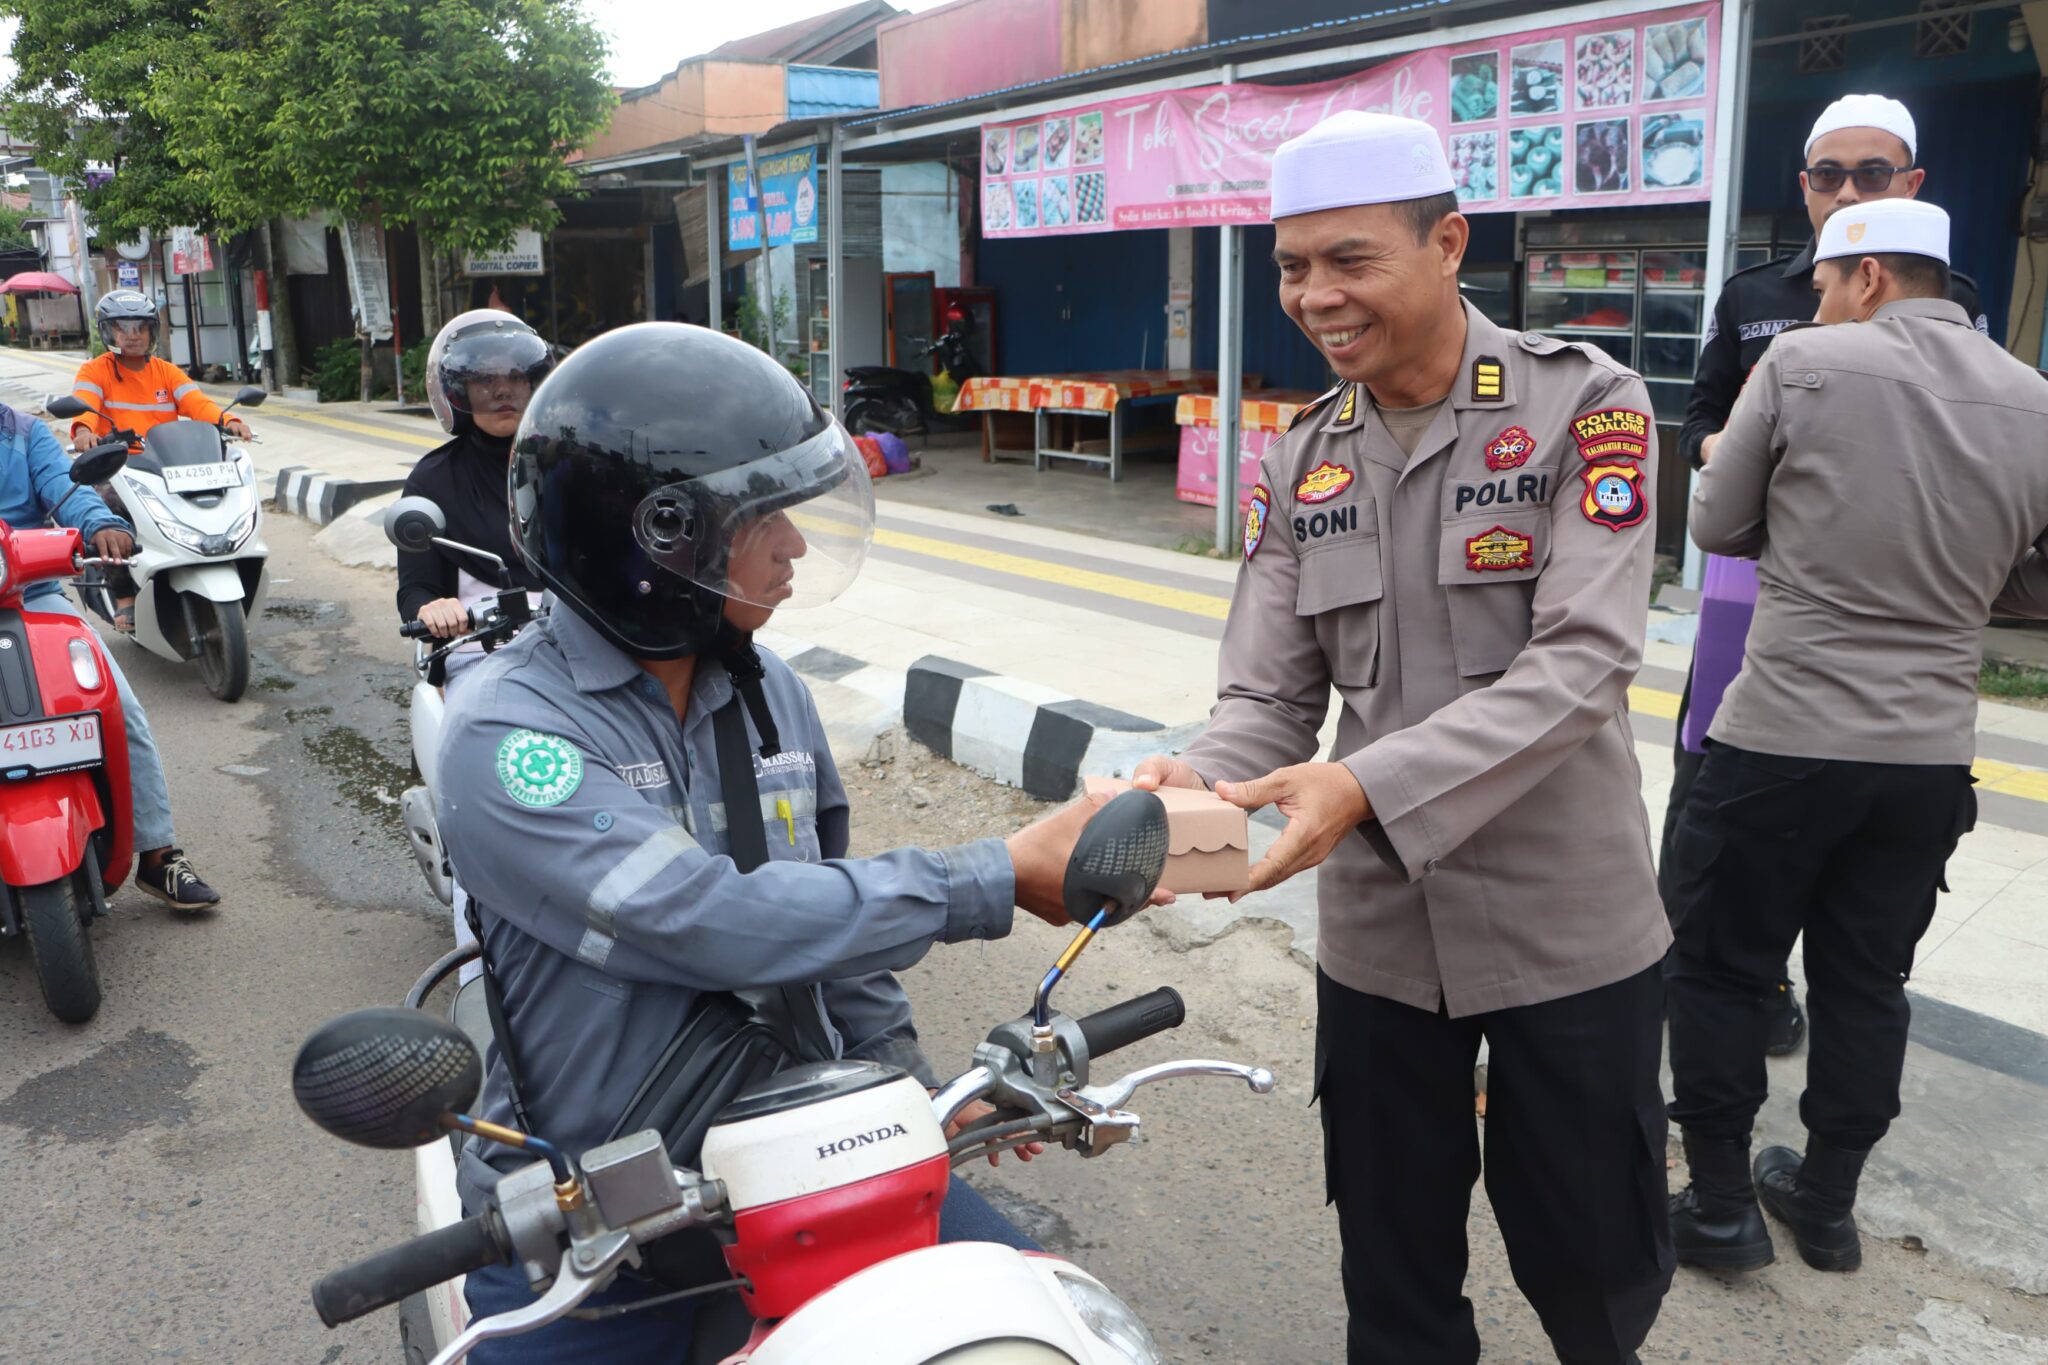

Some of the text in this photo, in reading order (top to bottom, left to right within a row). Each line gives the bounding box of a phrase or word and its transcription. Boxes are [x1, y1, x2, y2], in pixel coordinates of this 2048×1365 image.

[470, 261, 539, 271] DIGITAL COPIER
[1575, 411, 1645, 431] POLRES
[1579, 421, 1645, 439] TABALONG
[166, 469, 181, 480] DA
[185, 465, 213, 478] 4250
[1456, 473, 1548, 513] POLRI
[1293, 504, 1357, 543] SONI
[68, 721, 95, 743] XD
[35, 767, 68, 777] SEMAKIN
[77, 762, 102, 771] DEPAN
[816, 1123, 908, 1160] HONDA
